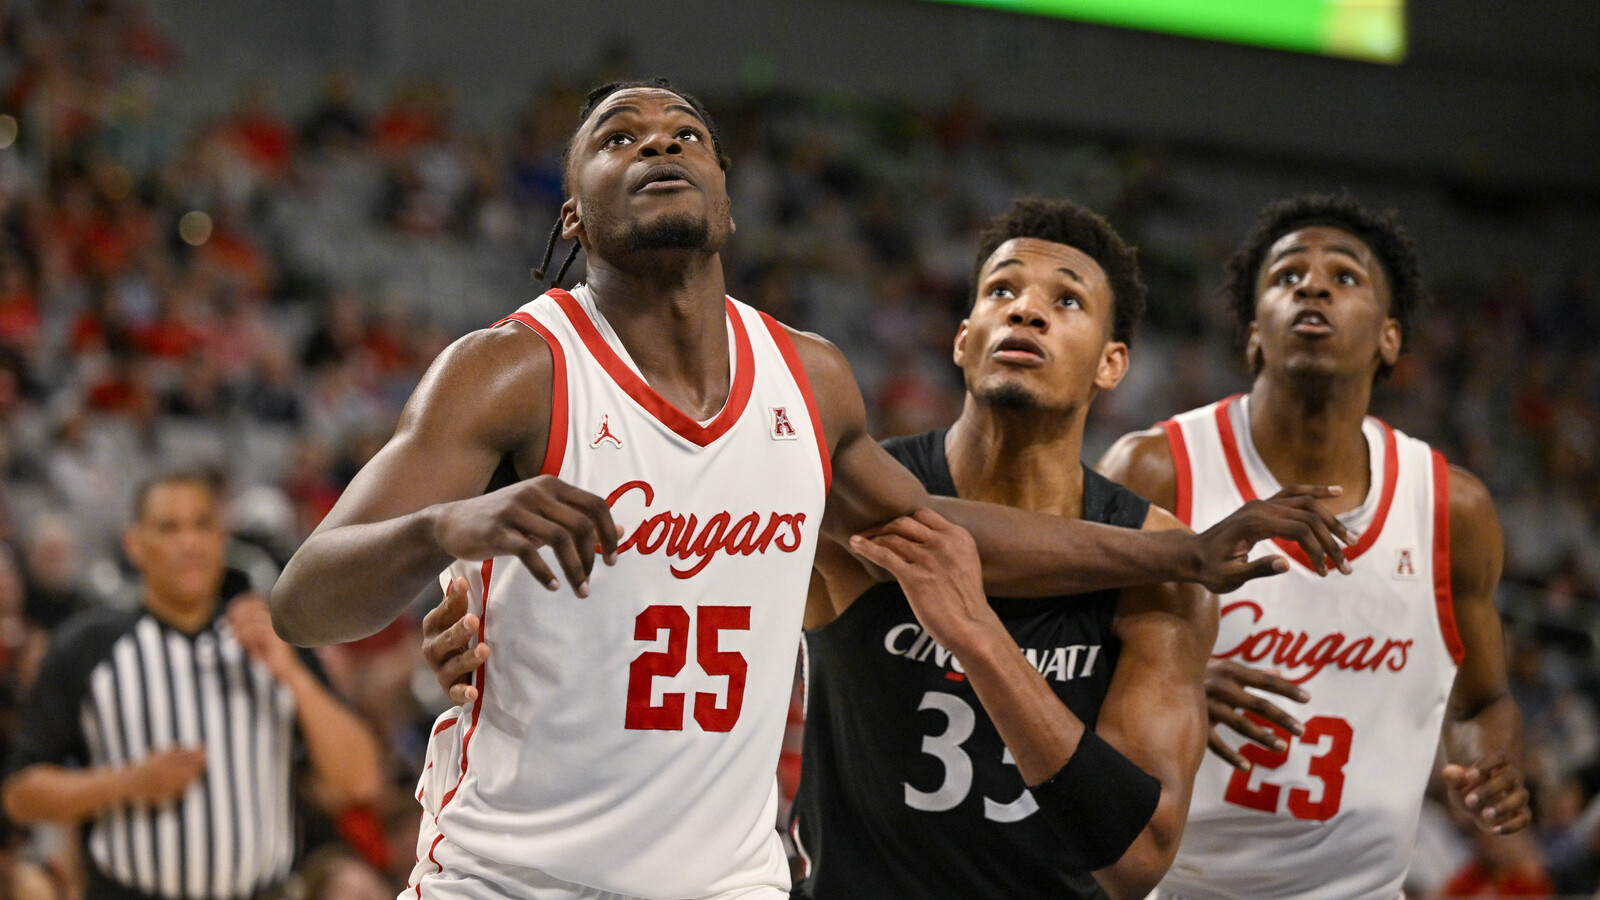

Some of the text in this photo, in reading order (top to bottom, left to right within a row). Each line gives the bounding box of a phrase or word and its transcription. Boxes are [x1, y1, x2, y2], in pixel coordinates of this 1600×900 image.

[594, 480, 807, 580] Cougars
[624, 604, 752, 733] 25
[883, 622, 1102, 682] CINNATI
[1210, 600, 1414, 686] Cougars
[1223, 708, 1354, 823] 23
